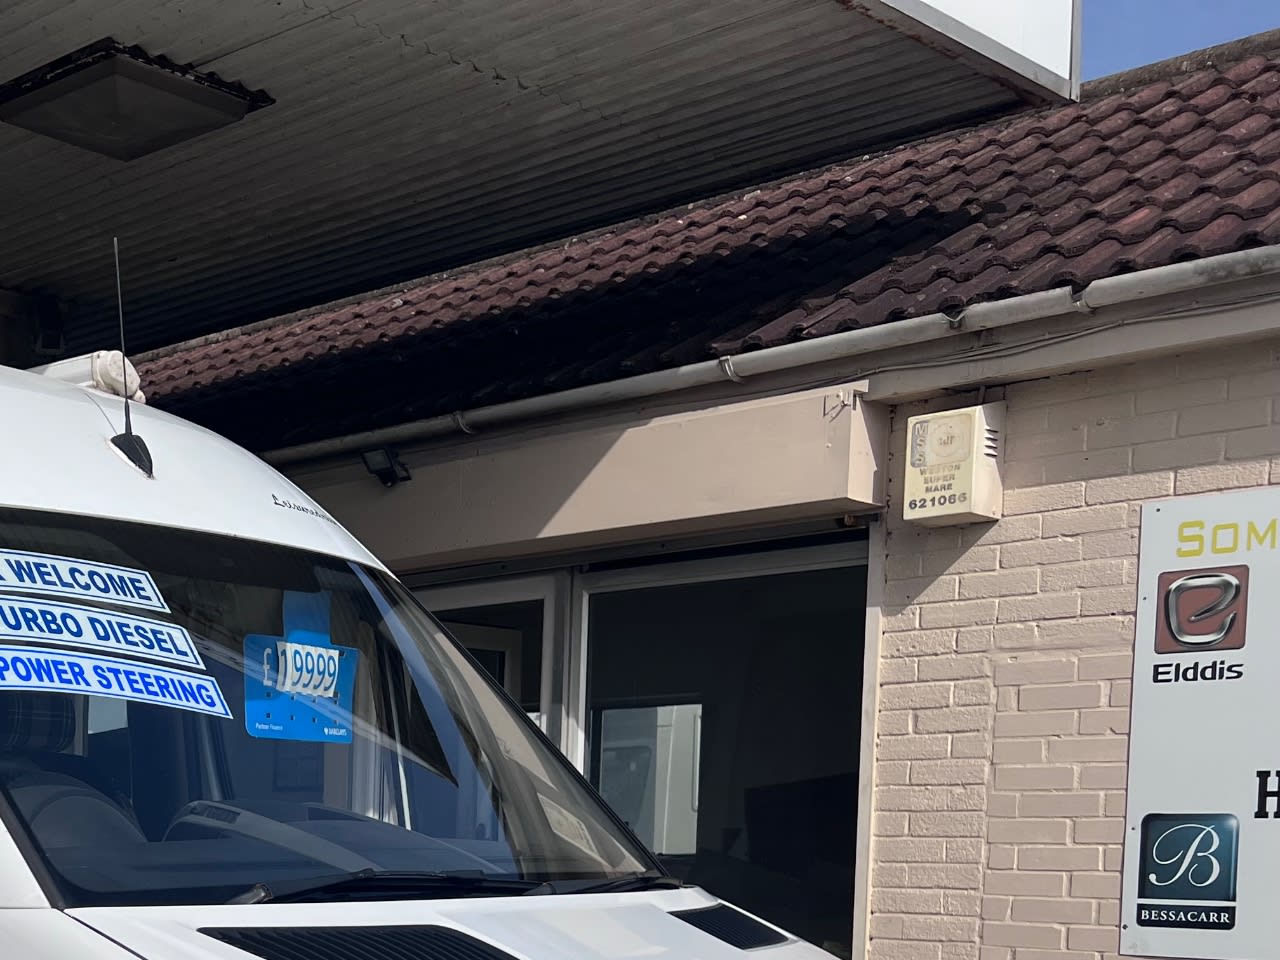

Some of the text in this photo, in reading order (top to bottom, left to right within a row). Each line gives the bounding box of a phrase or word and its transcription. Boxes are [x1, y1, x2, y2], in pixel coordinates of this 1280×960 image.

[925, 483, 953, 493] MARE
[5, 558, 153, 601] WELCOME
[87, 616, 189, 658] DIESEL
[1152, 660, 1244, 683] Elddis
[93, 671, 217, 708] STEERING
[1141, 909, 1230, 923] BESSACARR
